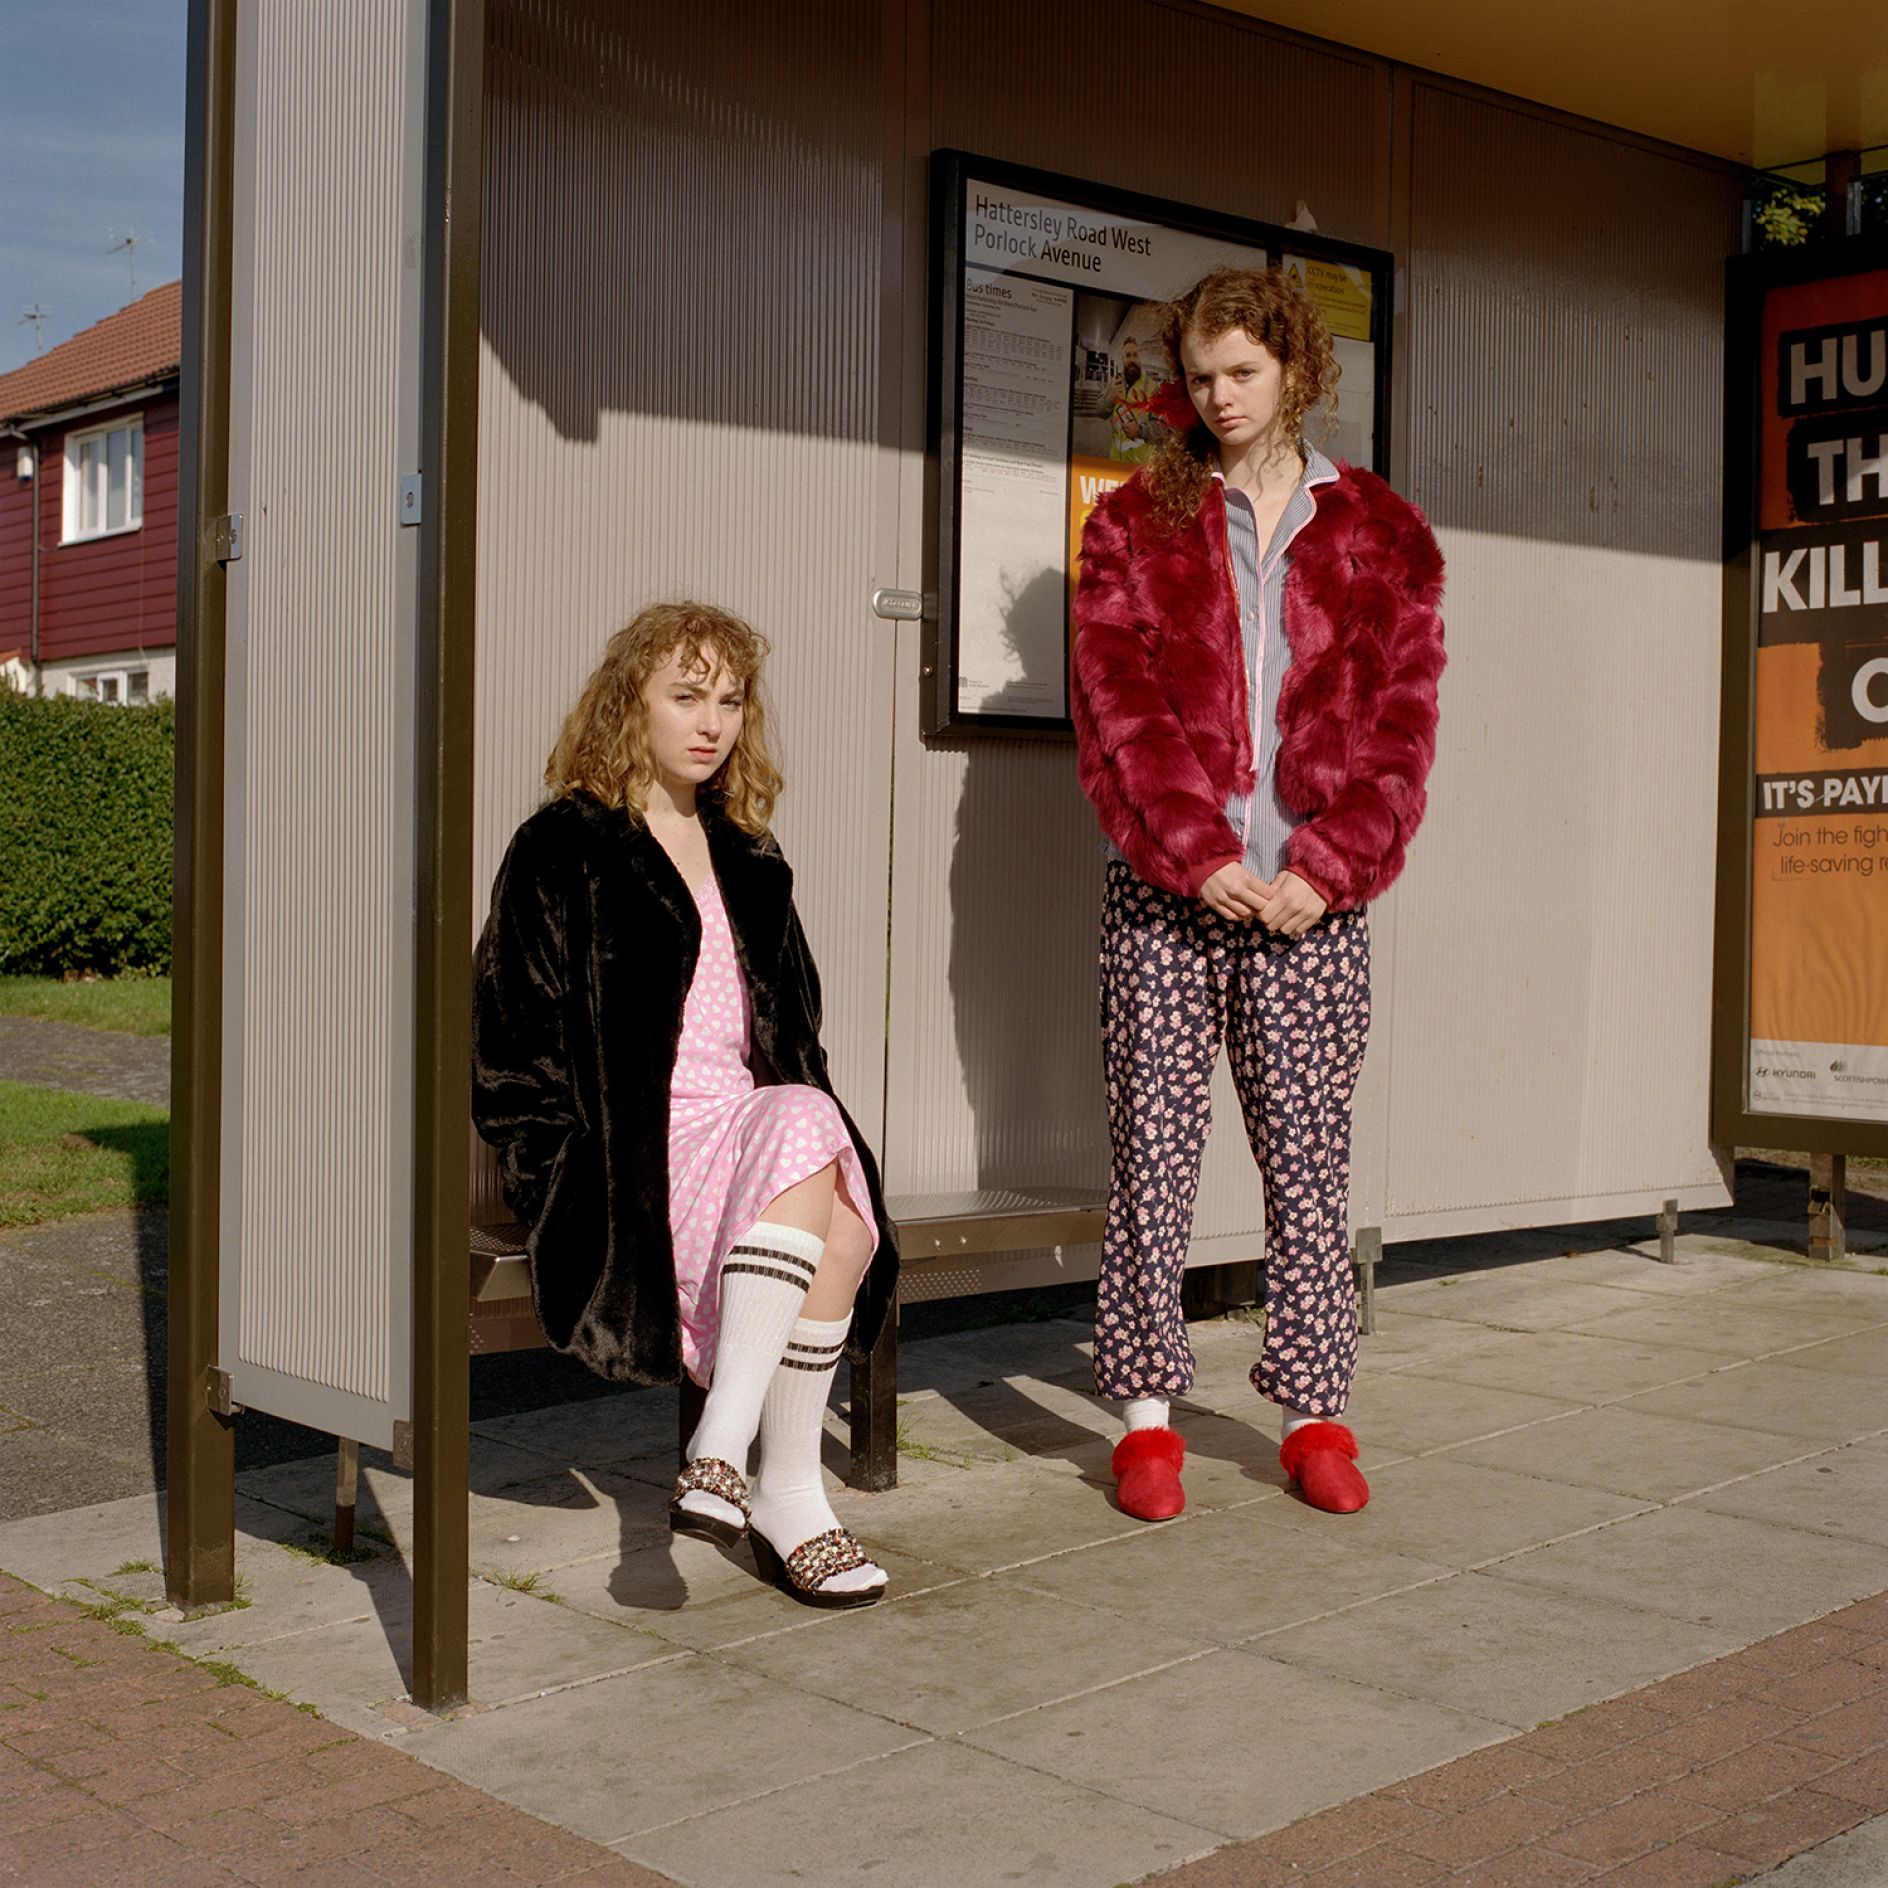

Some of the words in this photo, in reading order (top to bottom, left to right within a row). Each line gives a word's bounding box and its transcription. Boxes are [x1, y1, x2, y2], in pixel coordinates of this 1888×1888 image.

[976, 195, 1062, 241] Hattersley
[1067, 217, 1107, 246] Road
[1112, 227, 1151, 256] West
[975, 224, 1037, 258] Porlock
[1041, 240, 1101, 272] Avenue
[966, 279, 983, 293] Bus
[986, 283, 1012, 299] times
[1763, 540, 1888, 613] KILL
[1823, 775, 1888, 807] PAY
[1772, 828, 1811, 847] Join
[1816, 825, 1848, 845] the
[1780, 853, 1874, 876] life-saving
[1772, 1068, 1816, 1080] HYUNDAI
